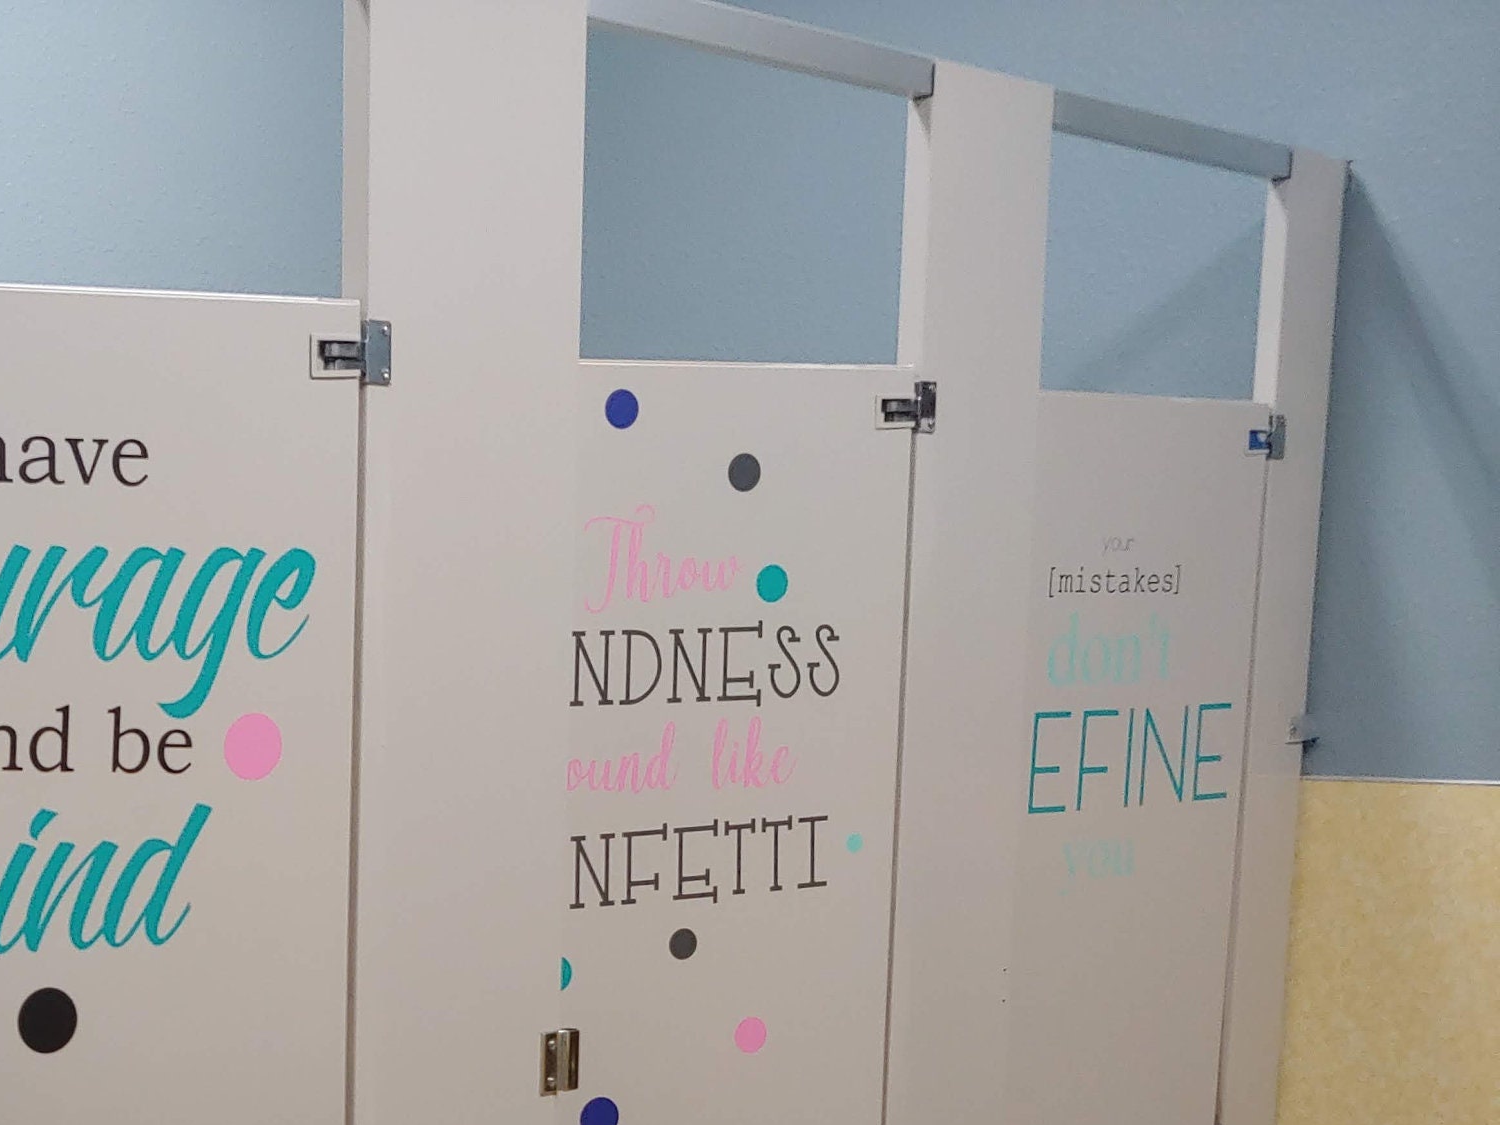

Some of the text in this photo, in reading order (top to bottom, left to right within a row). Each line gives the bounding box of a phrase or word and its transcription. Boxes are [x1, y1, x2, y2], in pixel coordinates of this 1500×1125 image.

[584, 503, 744, 614] Throw
[107, 706, 193, 776] be
[710, 716, 798, 790] like
